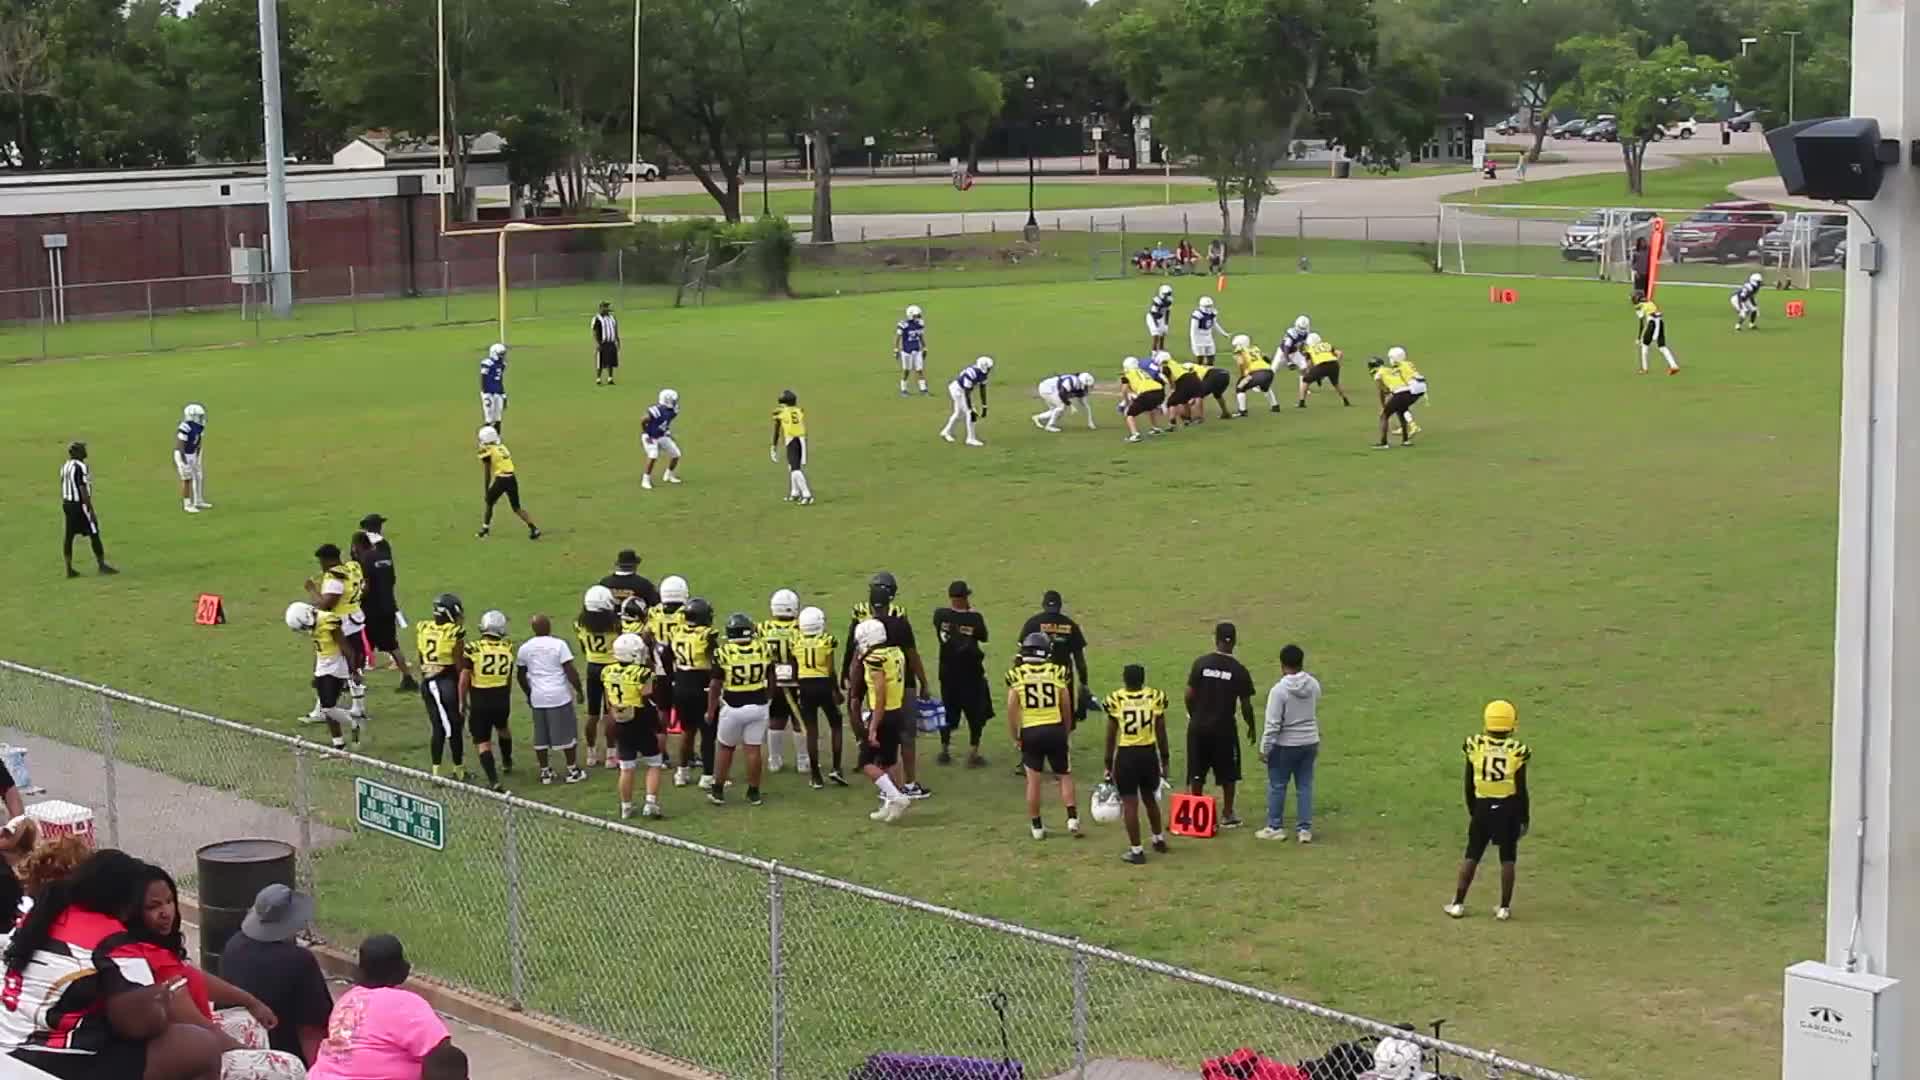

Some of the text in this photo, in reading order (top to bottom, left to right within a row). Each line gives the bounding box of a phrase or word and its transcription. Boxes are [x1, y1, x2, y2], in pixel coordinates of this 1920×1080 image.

[199, 600, 214, 622] 20
[427, 639, 438, 662] 2
[586, 635, 607, 654] 12
[482, 653, 510, 676] 22
[803, 647, 817, 669] 11
[611, 683, 623, 704] 7
[1024, 682, 1057, 708] 69
[1123, 709, 1153, 736] 24
[1481, 756, 1507, 782] 15
[1174, 799, 1210, 833] 40
[1799, 1020, 1853, 1038] CAROLINA
